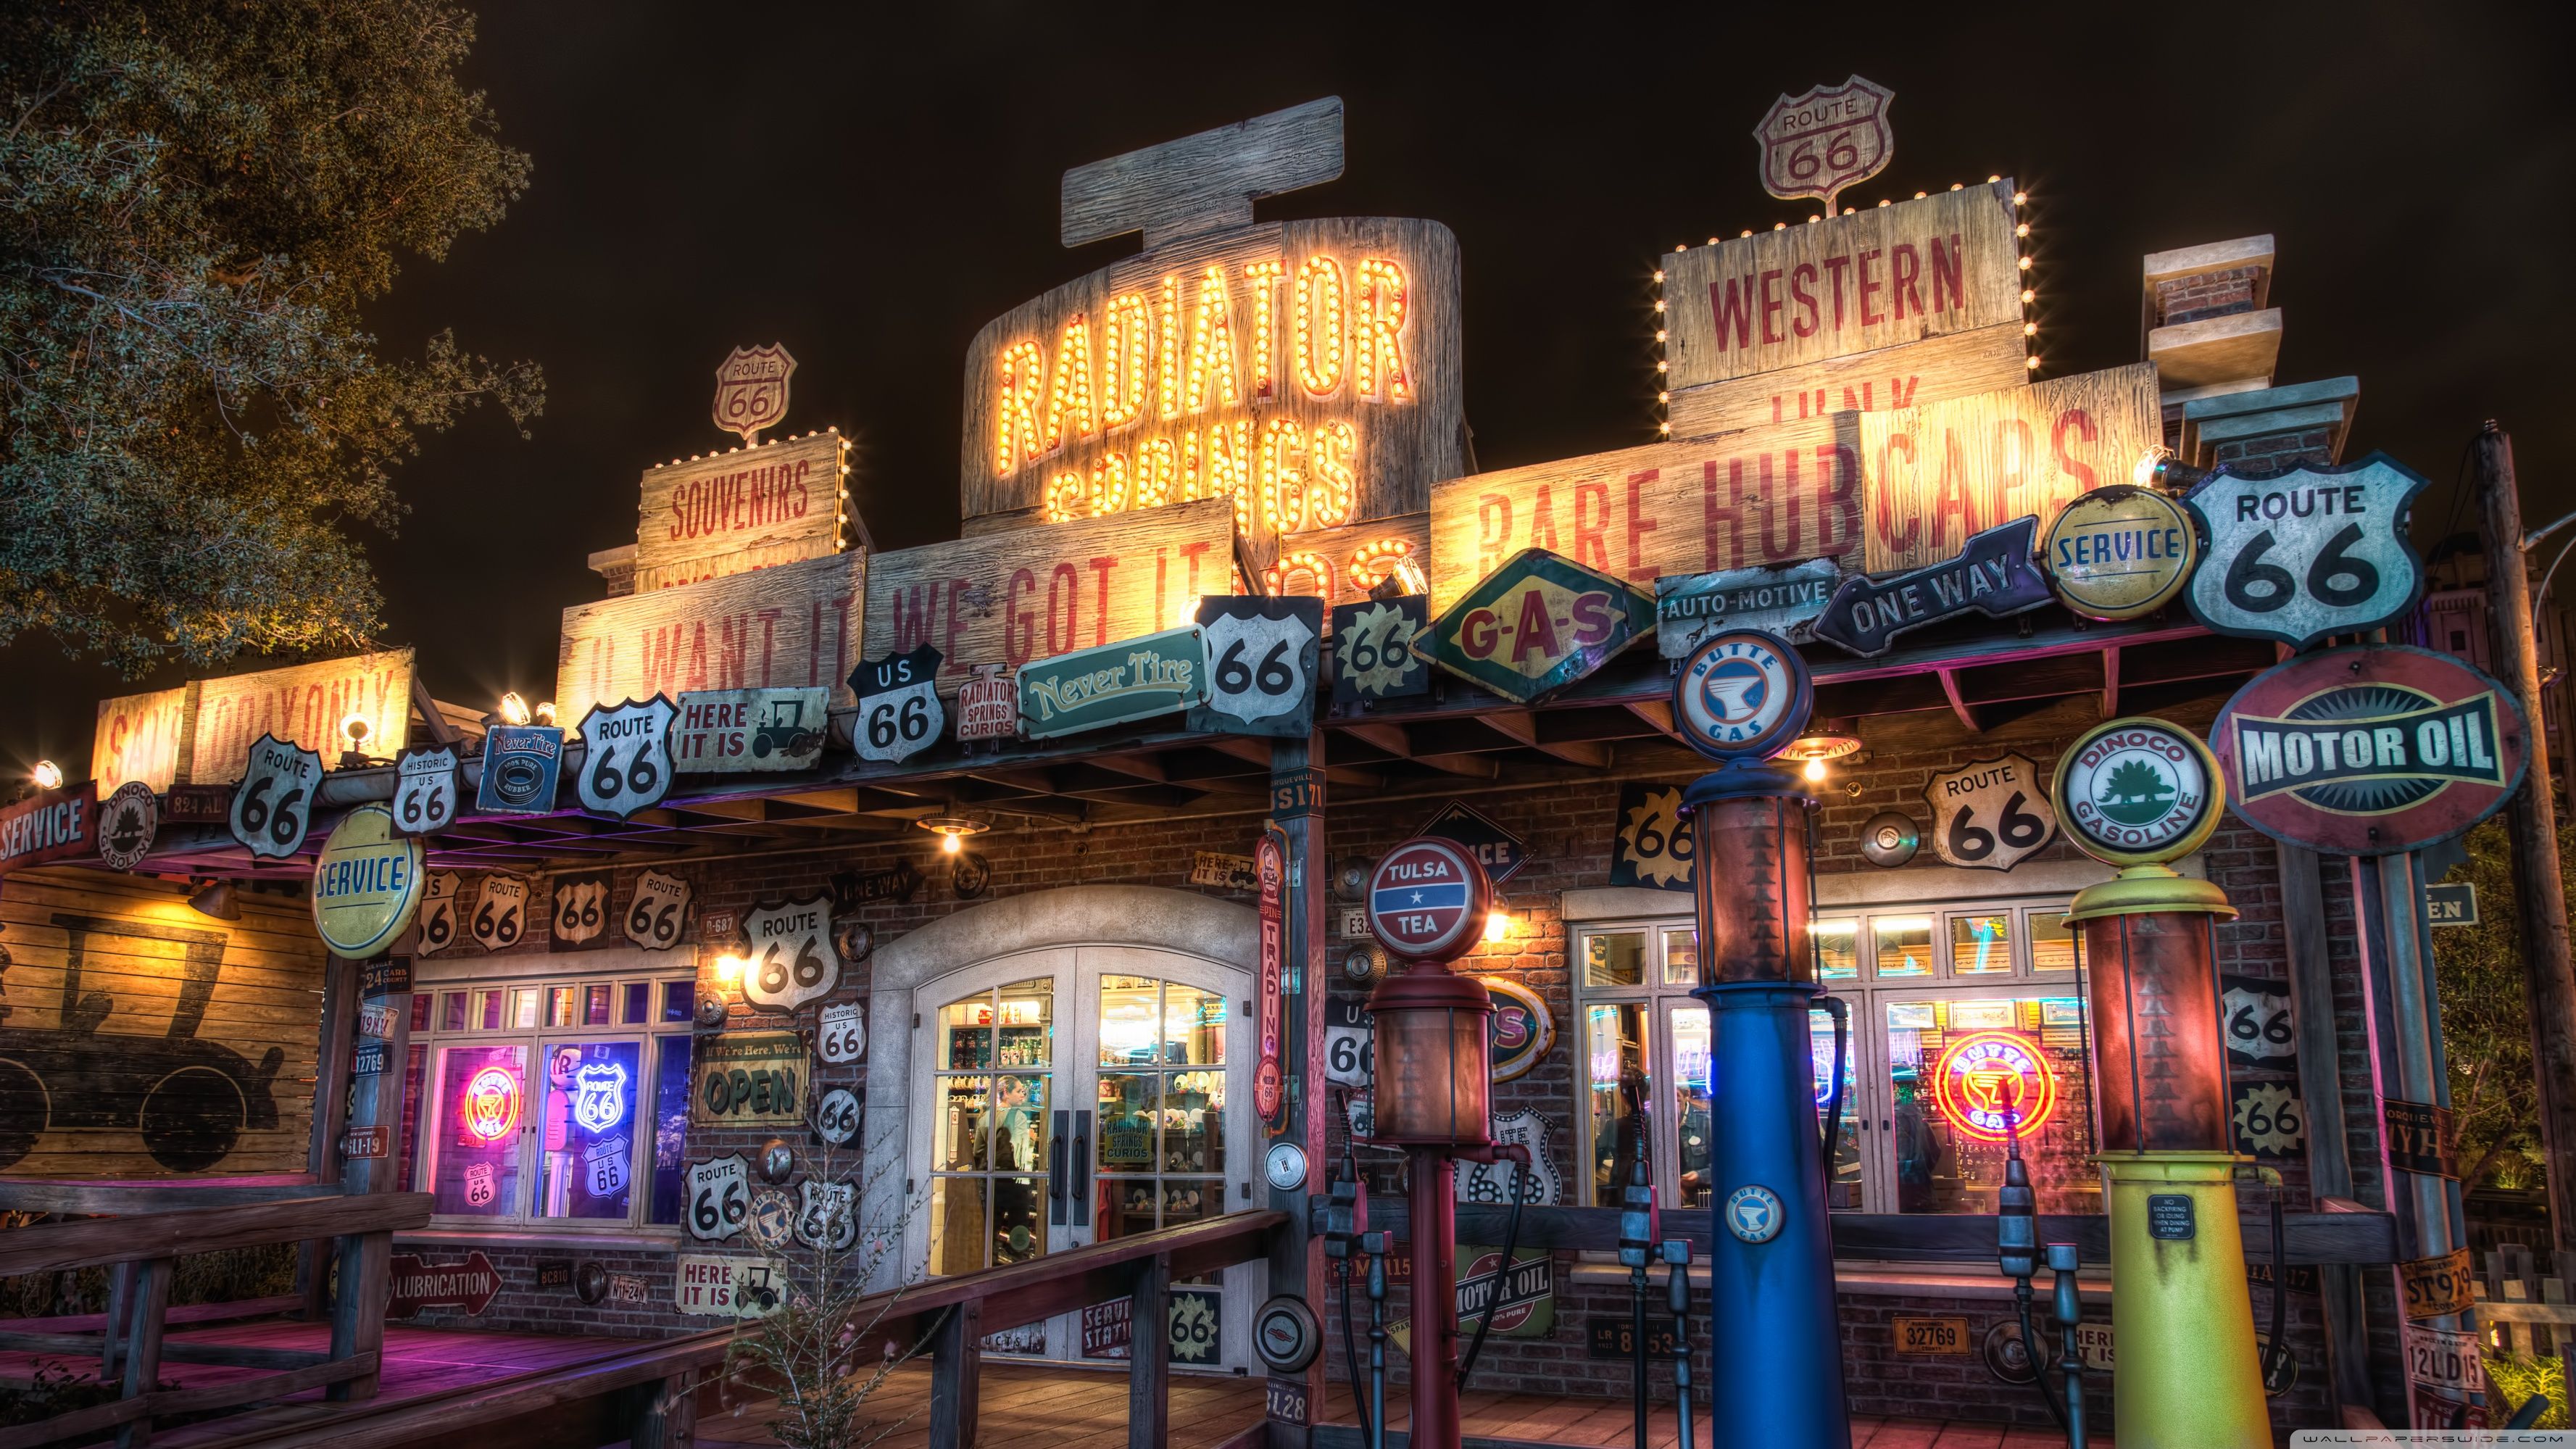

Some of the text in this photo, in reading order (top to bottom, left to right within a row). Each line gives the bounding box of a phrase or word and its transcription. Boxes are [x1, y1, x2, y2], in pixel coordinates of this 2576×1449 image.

[1783, 98, 1858, 131] ROUTE
[1787, 130, 1858, 180] 66
[1709, 233, 1964, 353] WESTERN
[733, 361, 776, 376] ROUTE
[998, 255, 1415, 478] RADIATOR
[728, 385, 768, 418] 66
[670, 459, 809, 541] SOUVENIRS
[2235, 484, 2367, 523] ROUTE
[2057, 527, 2180, 568] SERVICE
[2224, 521, 2380, 613] 66
[894, 578, 970, 676] WE
[1006, 555, 1118, 668] GOT
[1155, 541, 1210, 629] IT
[1668, 581, 1827, 618] AUTO-MOTIVE
[1851, 554, 2011, 634] ONE WAY
[1461, 589, 1613, 663] G-A-S
[642, 594, 855, 702] WANT IT
[1350, 623, 1409, 671] 66
[1692, 643, 1779, 678] BUTTE
[878, 660, 911, 687] US
[1214, 637, 1294, 696] 66
[961, 681, 1014, 705] RADIATOR
[1029, 649, 1192, 721] Never Tire
[685, 702, 748, 729] HERE
[868, 696, 930, 748] 66
[968, 702, 1007, 723] SPRINGS
[599, 715, 654, 740] ROUTE
[960, 721, 1013, 736] CURIOS
[1709, 719, 1763, 742] GAS
[494, 733, 557, 755] Never Tire
[682, 731, 745, 760] IT IS
[2080, 732, 2186, 771] DINOCO
[2240, 710, 2494, 786] MOTOR OIL
[264, 749, 310, 779] ROUTE
[407, 757, 448, 771] HISTORIC
[521, 759, 537, 771] PURE
[592, 740, 657, 799] 66
[419, 776, 433, 786] US
[504, 784, 531, 792] RUBBER
[1945, 765, 2015, 797] ROUTE
[108, 784, 154, 810] DINOCO
[241, 776, 304, 845] 66
[402, 789, 444, 823] 66
[0, 798, 83, 861] SERVICE
[1948, 791, 2045, 861] 66
[2075, 791, 2201, 846] GASOLINE
[100, 827, 154, 869] GASOLINE
[1634, 811, 1693, 859] 66
[317, 855, 404, 898] SERVICE
[1197, 869, 1227, 882] IT IS
[1198, 856, 1228, 869] HERE
[1389, 861, 1448, 881] TULSA
[489, 881, 520, 897] ROUTE
[647, 879, 681, 897] ROUTE
[420, 904, 449, 943] 6
[475, 901, 518, 942] 66
[562, 896, 600, 929] 66
[631, 897, 678, 941] 66
[763, 912, 818, 937] ROUTE
[1264, 905, 1277, 918] PIN
[1397, 915, 1437, 934] TEA
[759, 934, 824, 995] 66
[1264, 925, 1277, 1047] TRADING
[824, 1008, 857, 1020] HISTORIC
[2230, 1004, 2293, 1045] 66
[744, 1045, 771, 1056] Here,
[826, 1029, 859, 1057] 66
[1953, 1044, 2032, 1073] BUTTE
[586, 1080, 615, 1092] ROUTE
[704, 1067, 795, 1116] OPEN
[1265, 1087, 1273, 1097] 66
[585, 1092, 616, 1121] 66
[820, 1100, 855, 1131] 66
[2247, 1100, 2300, 1135] 66
[1108, 1118, 1149, 1136] RADIATOR
[1113, 1135, 1143, 1148] SPRINGS
[596, 1143, 612, 1157] ROUTE
[599, 1157, 613, 1168] US
[1107, 1149, 1148, 1158] CURIOS
[470, 1167, 488, 1177] ROUTE
[597, 1169, 618, 1190] 66
[697, 1163, 736, 1183] ROUTE
[471, 1189, 489, 1203] 66
[694, 1181, 747, 1231] 66
[810, 1186, 846, 1203] ROUTE
[1731, 1188, 1774, 1206] BUTTE
[804, 1205, 846, 1239] 66
[1739, 1230, 1767, 1240] GAS
[396, 1272, 490, 1298] LUBRICATION
[685, 1263, 731, 1284] HERE
[1518, 1266, 1547, 1295] OIL
[684, 1287, 730, 1306] IT IS
[1171, 1311, 1208, 1342] 66
[1490, 1308, 1526, 1322] 00% PURE
[1086, 1319, 1131, 1350] STATI
[1907, 1327, 1956, 1345] 32769
[2100, 1348, 2114, 1362] IS
